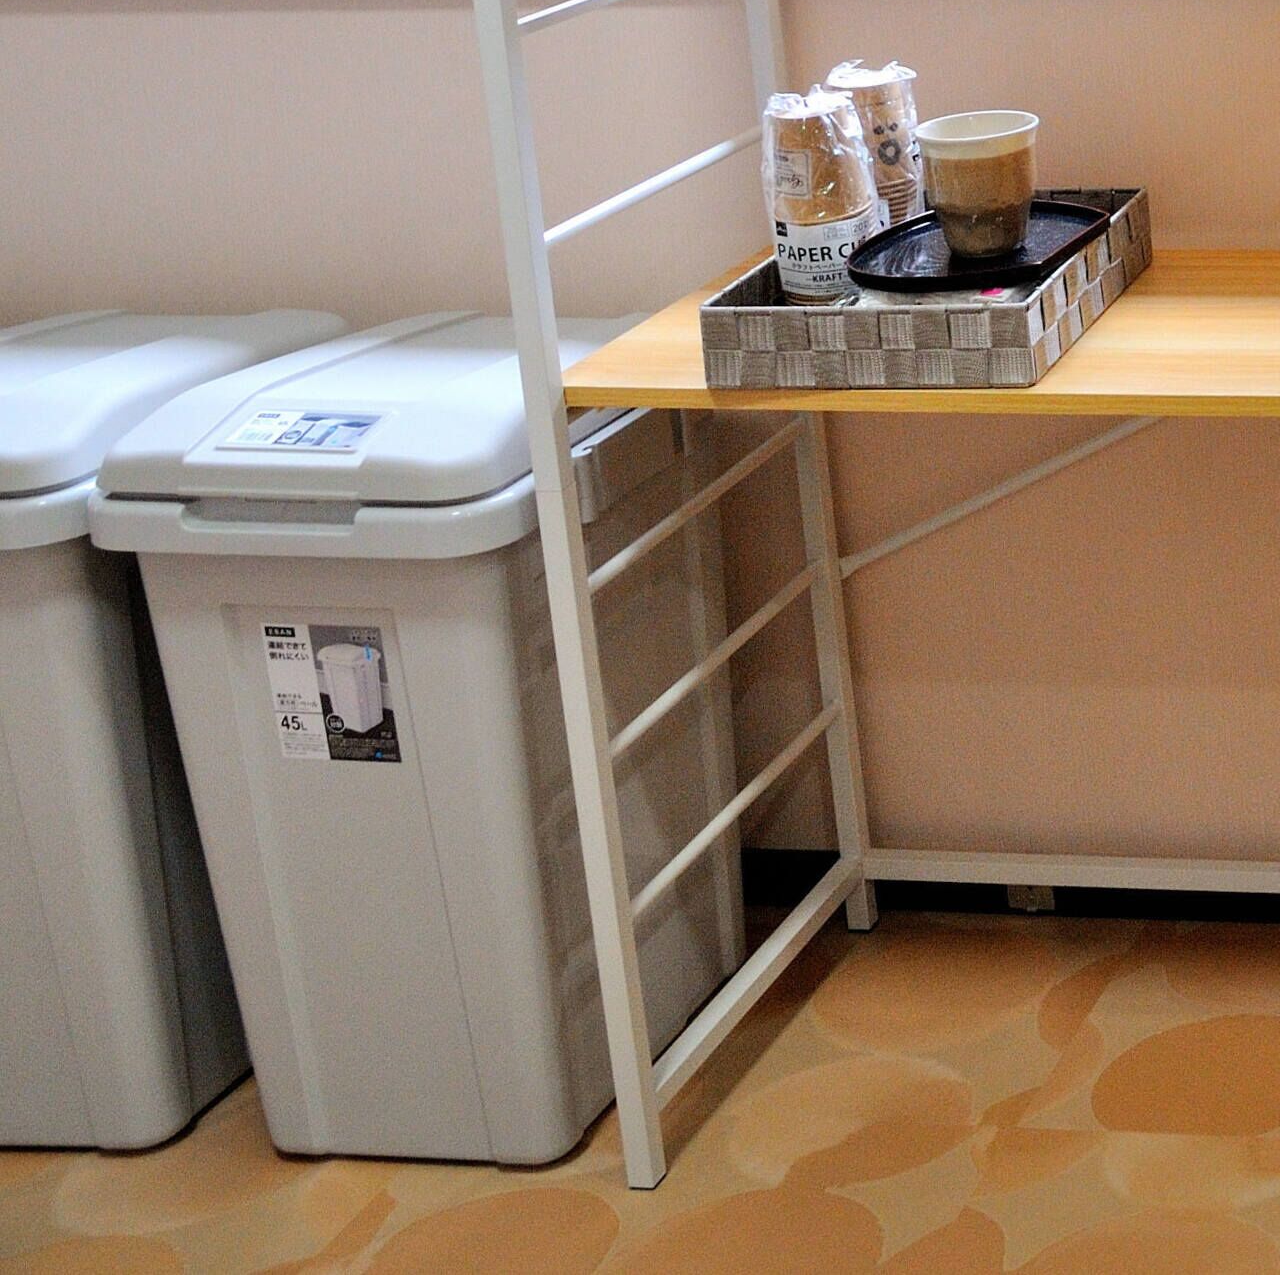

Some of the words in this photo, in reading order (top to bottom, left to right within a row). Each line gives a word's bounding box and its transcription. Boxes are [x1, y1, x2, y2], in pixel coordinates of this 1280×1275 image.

[777, 243, 833, 263] PAPER
[812, 272, 843, 283] KRAFT
[281, 714, 308, 731] 45L
